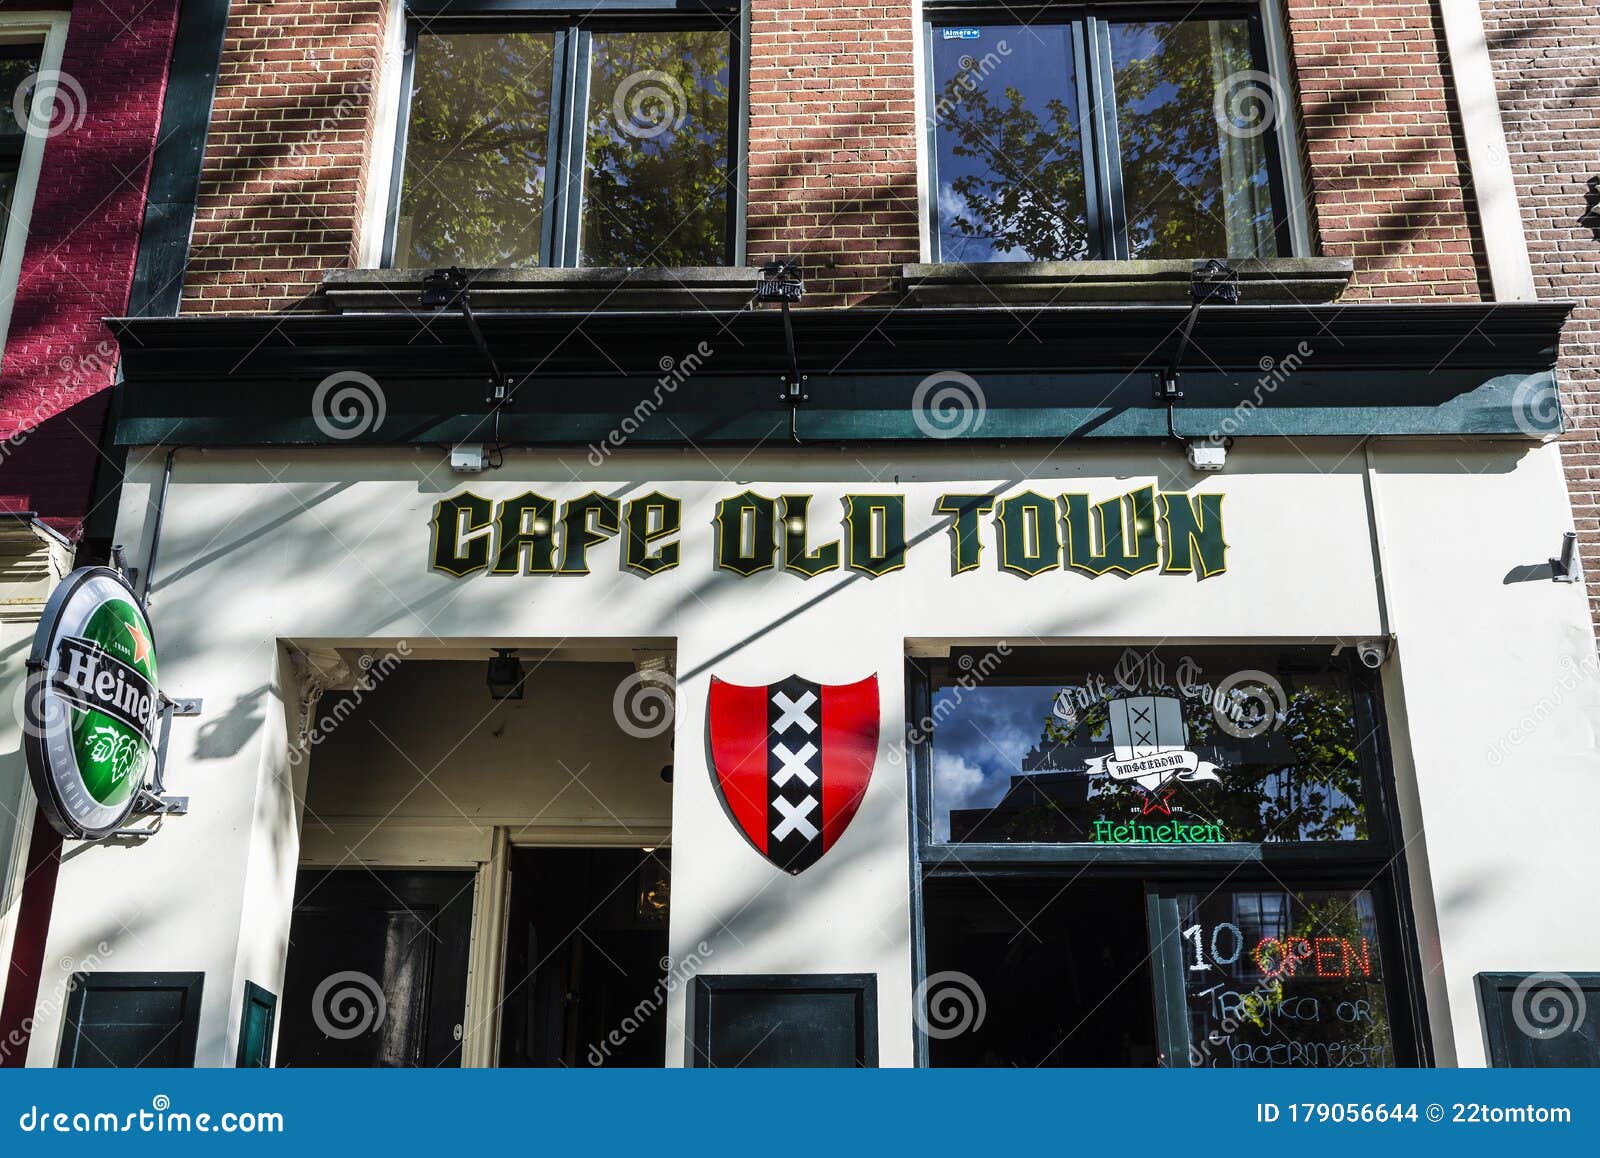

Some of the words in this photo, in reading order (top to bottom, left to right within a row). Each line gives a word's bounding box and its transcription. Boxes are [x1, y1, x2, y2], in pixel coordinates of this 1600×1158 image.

[713, 489, 909, 577] OLD
[937, 483, 1231, 578] TOWN
[1093, 819, 1225, 843] Heineken
[1183, 922, 1243, 972] 10
[1255, 936, 1371, 977] OPEN
